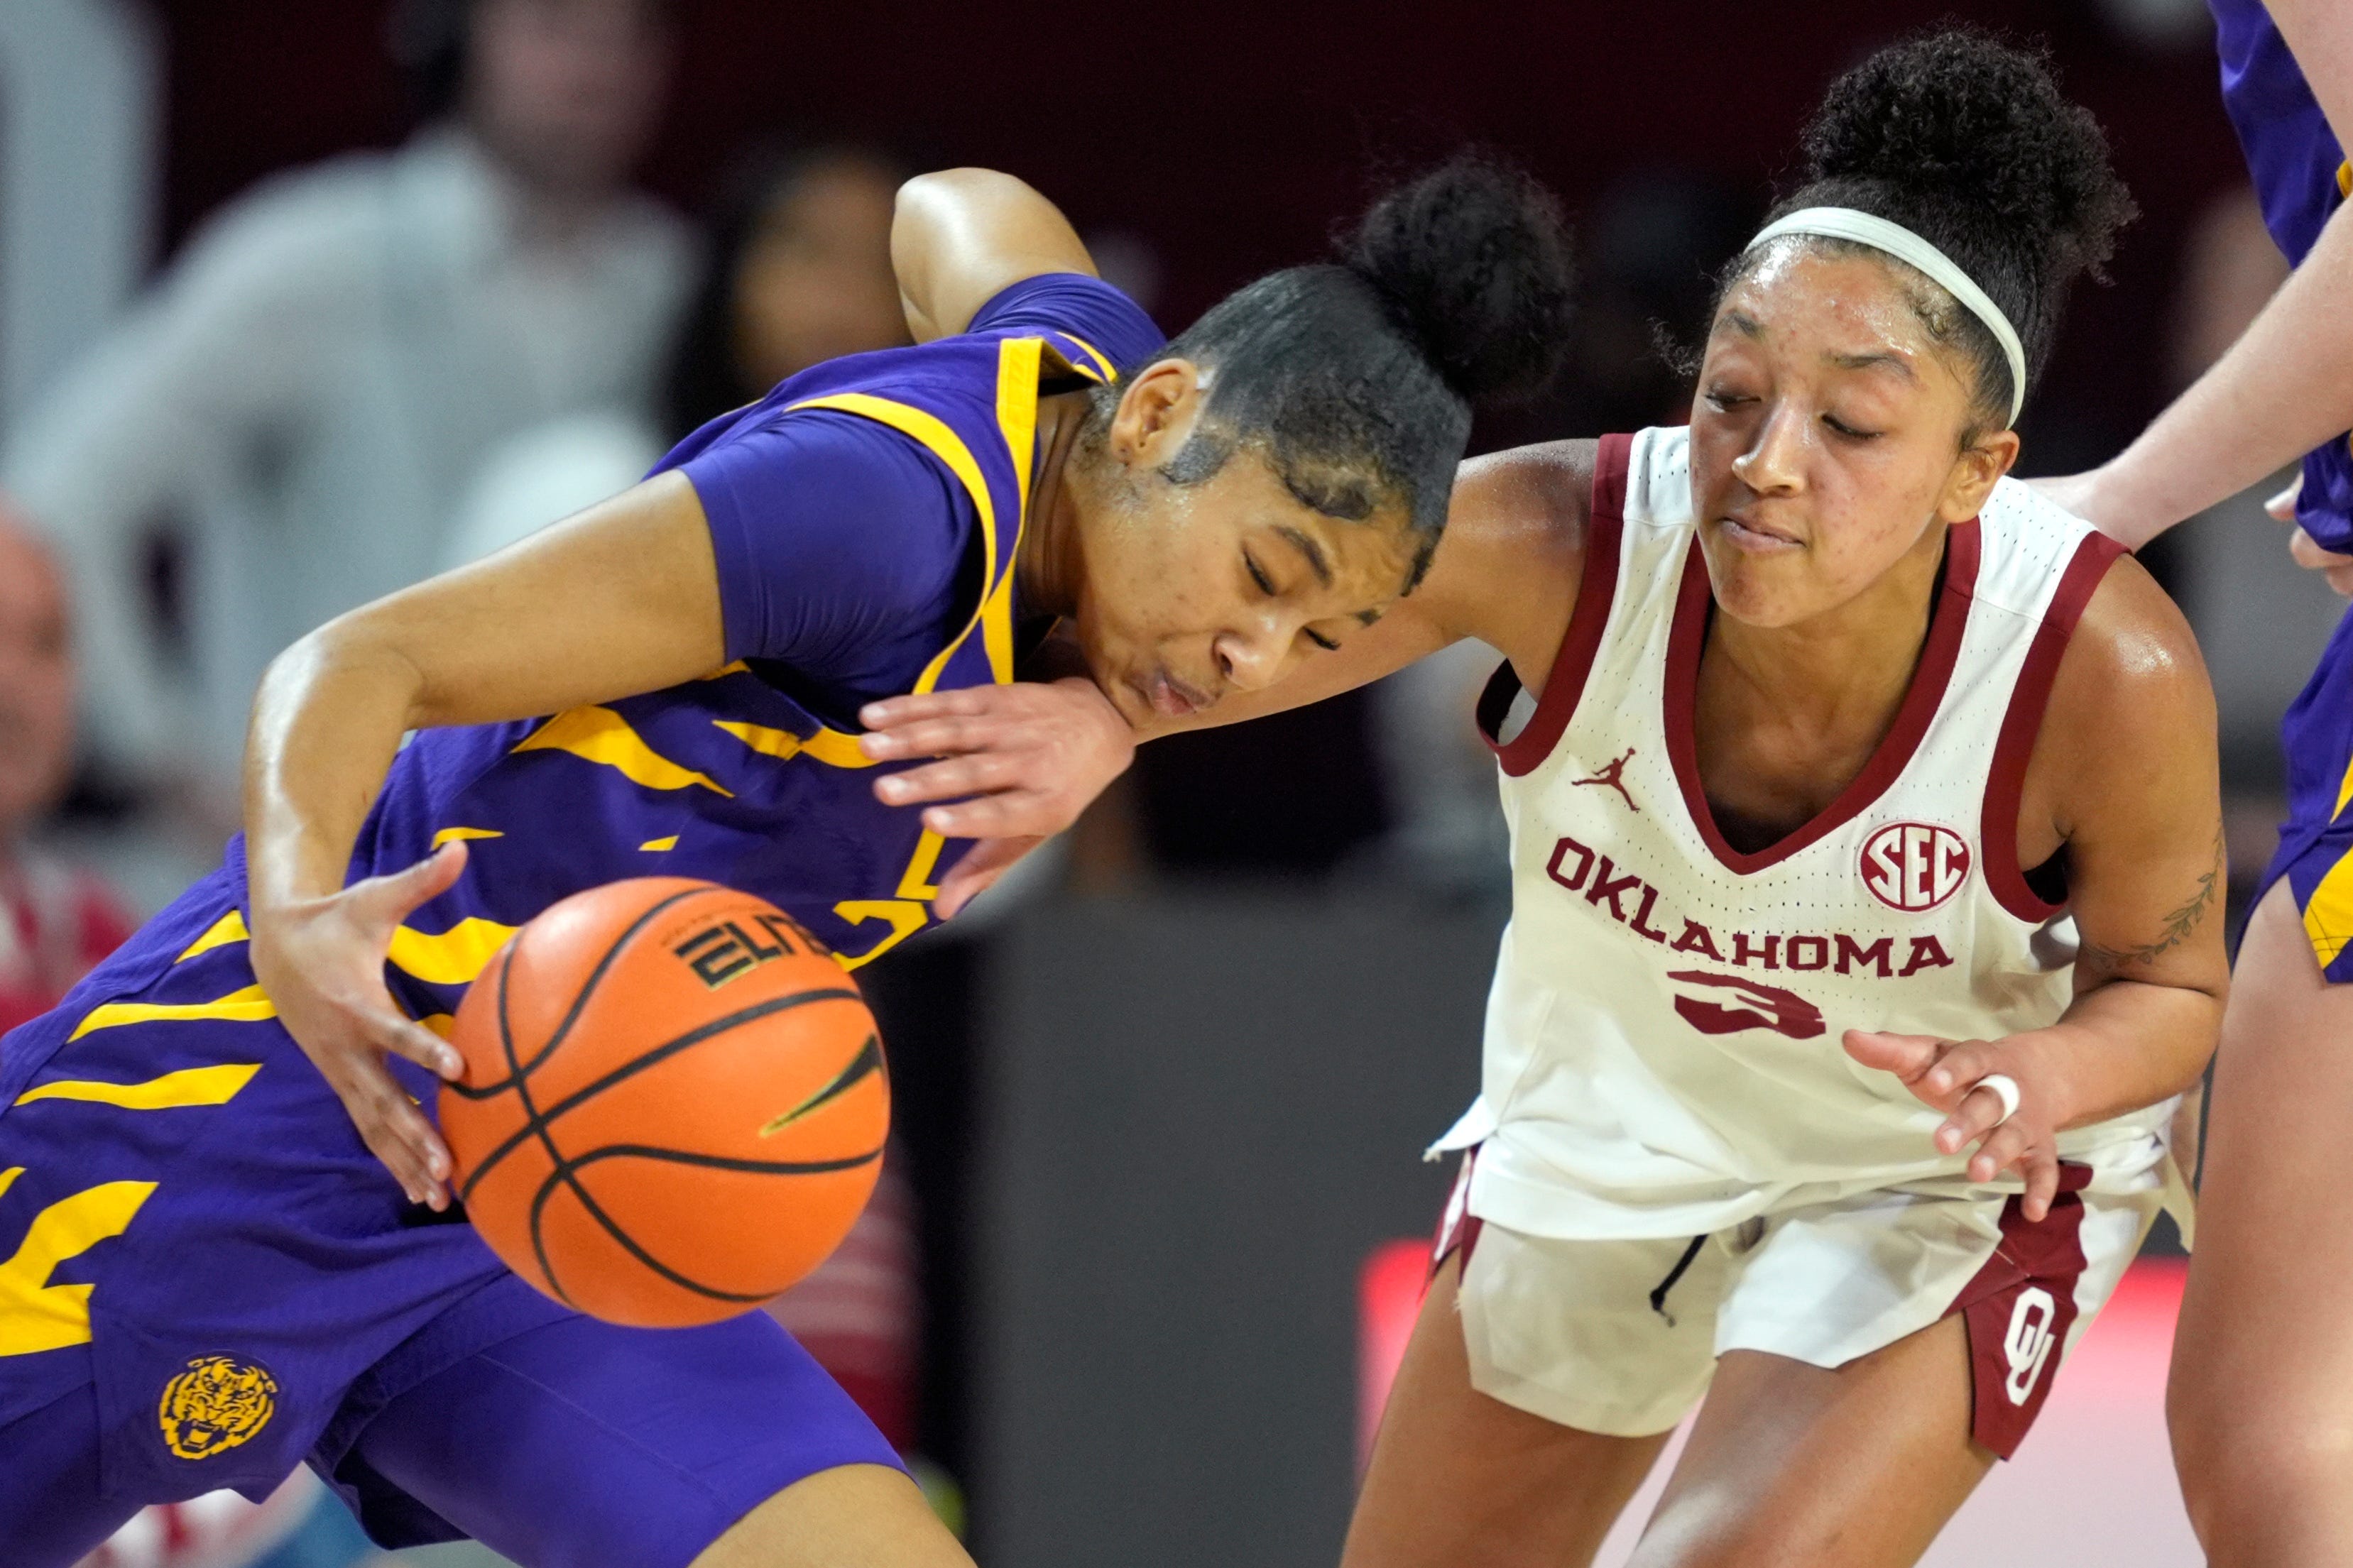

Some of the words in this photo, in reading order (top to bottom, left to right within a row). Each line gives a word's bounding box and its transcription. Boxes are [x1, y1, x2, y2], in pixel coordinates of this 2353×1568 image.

[1546, 836, 1955, 978] OKLAHOMA
[1867, 826, 1965, 907] SEC
[2003, 1285, 2056, 1407] OU
